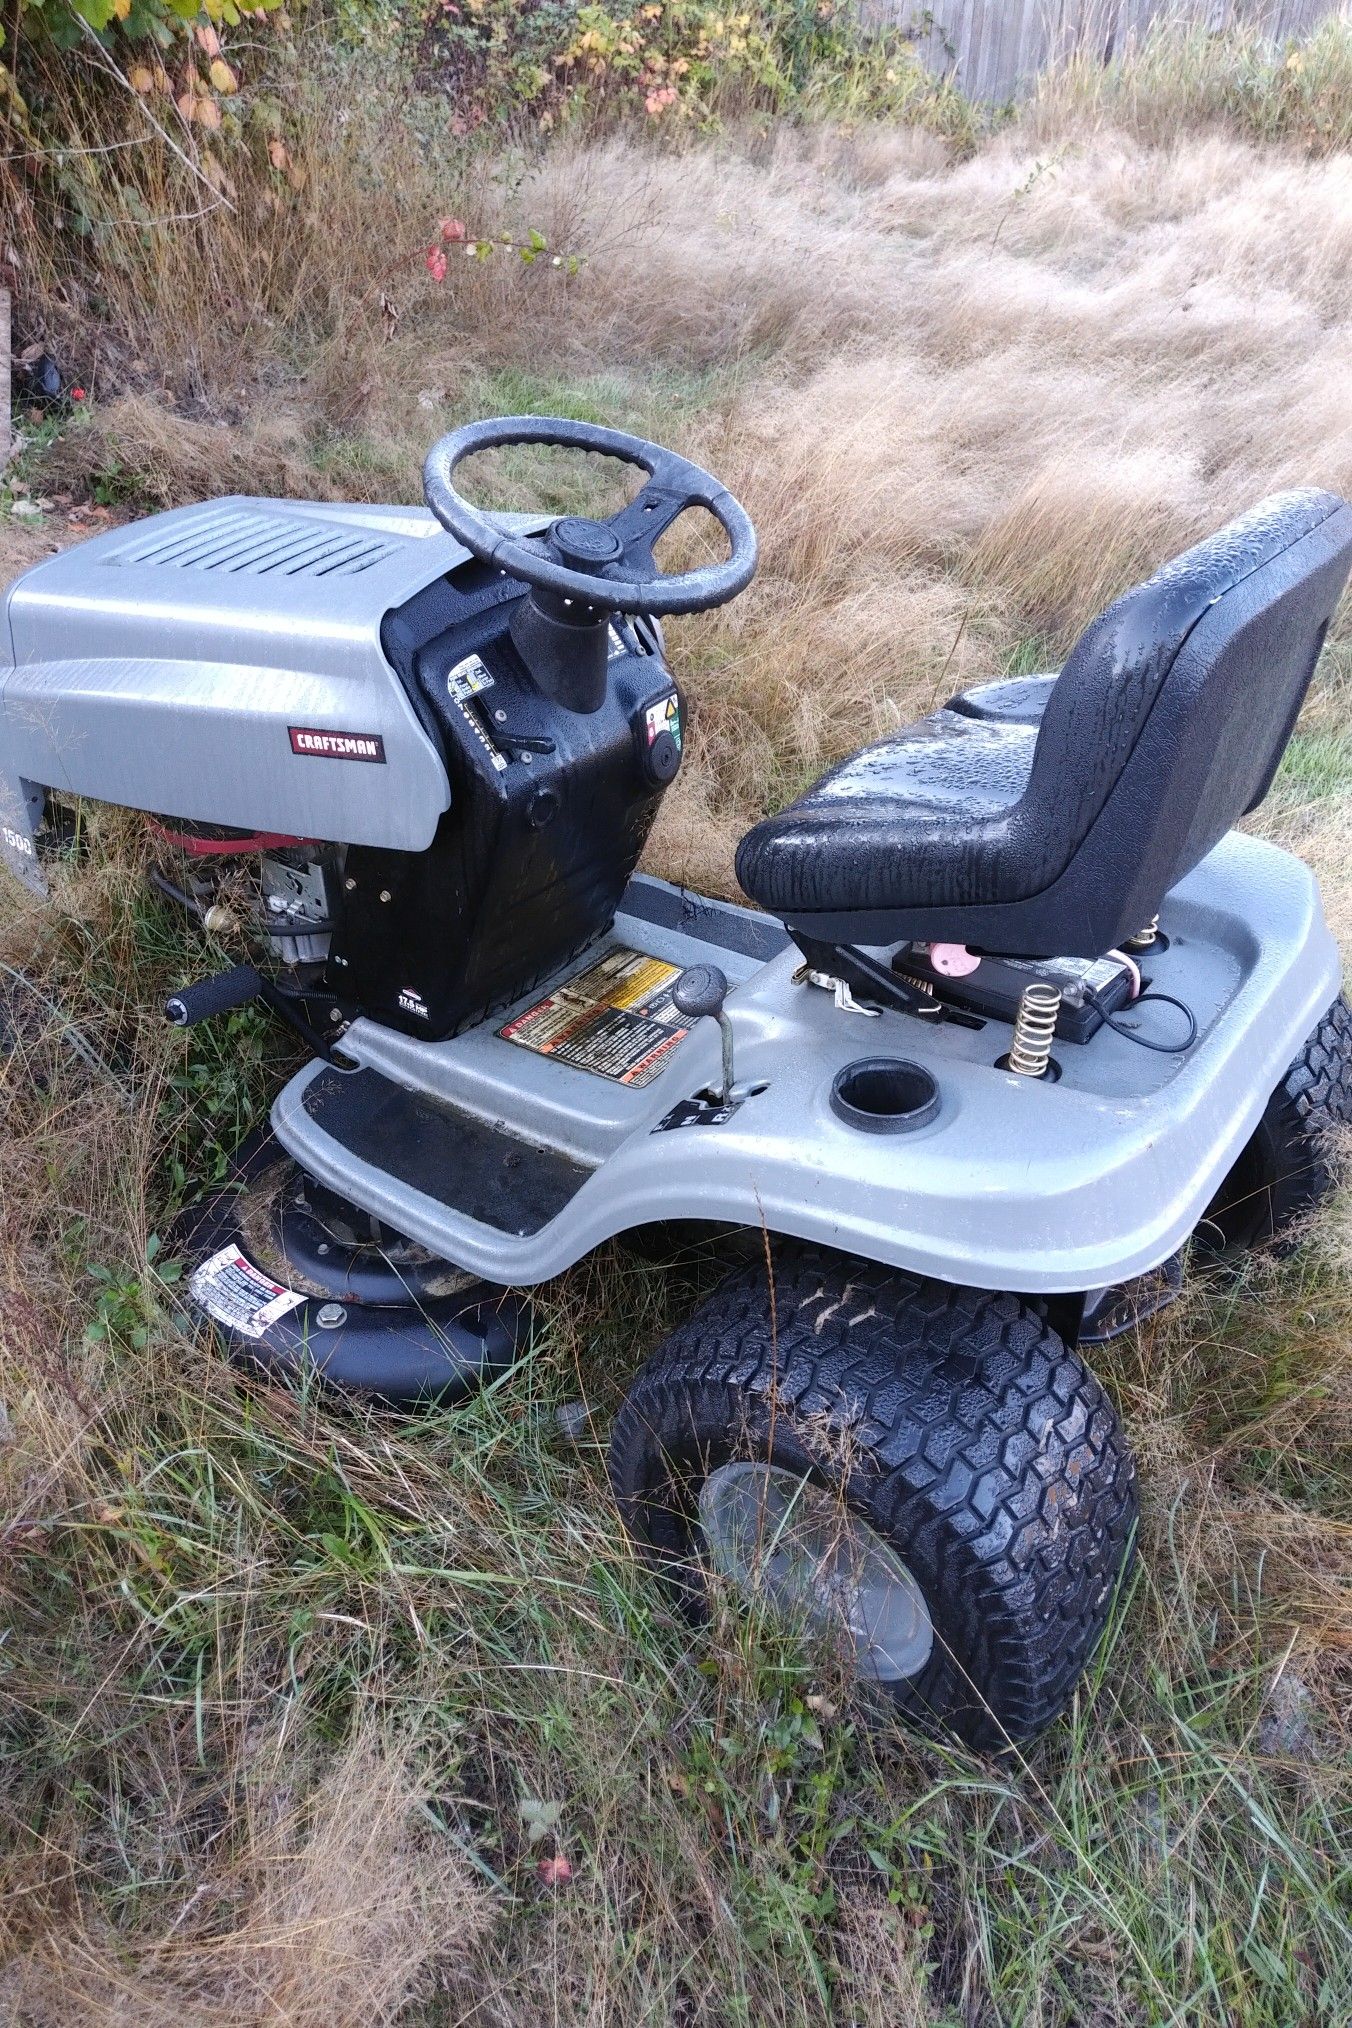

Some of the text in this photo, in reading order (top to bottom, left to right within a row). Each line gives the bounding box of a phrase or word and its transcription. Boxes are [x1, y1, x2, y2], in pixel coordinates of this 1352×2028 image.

[296, 733, 377, 756] CRAFTSMAN
[515, 1002, 551, 1029] DANGER
[638, 1035, 679, 1069] WARNING
[245, 1269, 276, 1289] DANGER
